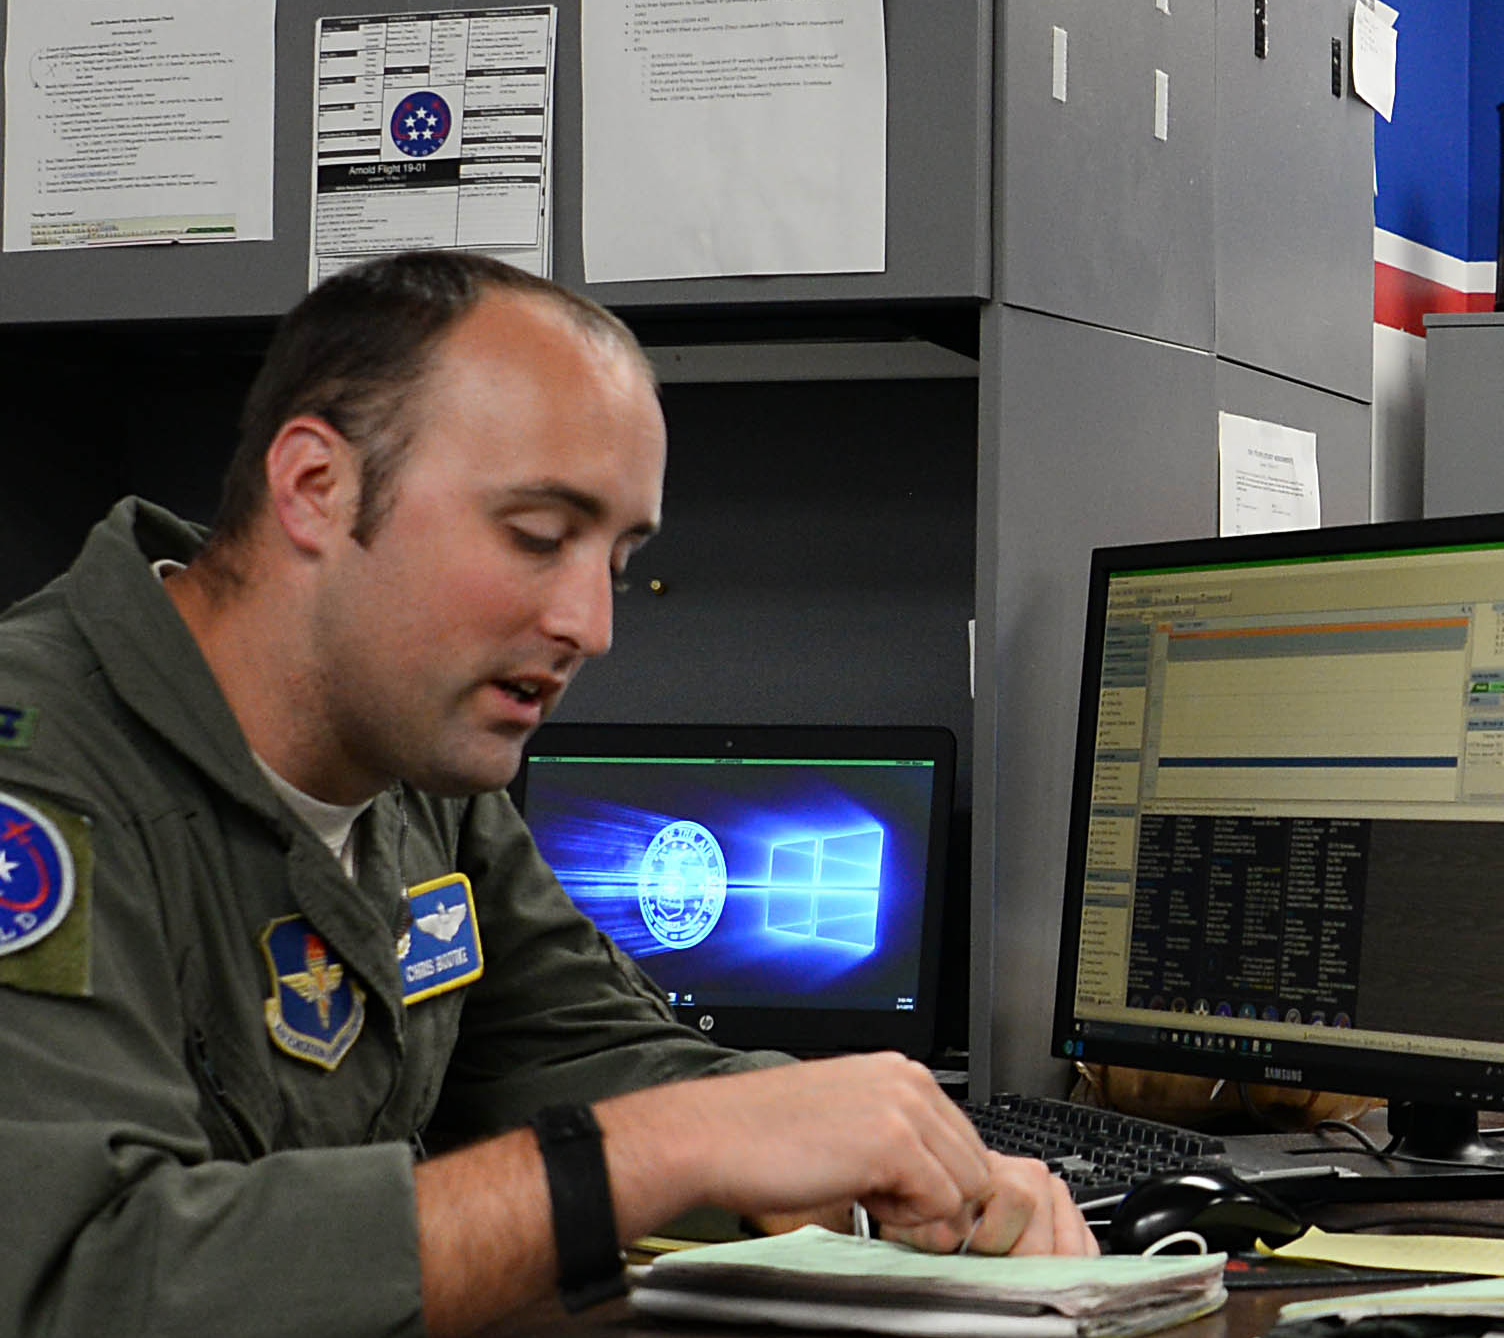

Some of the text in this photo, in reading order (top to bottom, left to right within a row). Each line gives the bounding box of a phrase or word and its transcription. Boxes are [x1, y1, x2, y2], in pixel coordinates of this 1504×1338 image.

[348, 162, 427, 176] Arnold Flight 19-01
[405, 958, 436, 982] CHRIS
[1264, 1065, 1303, 1082] SAMSUNG
